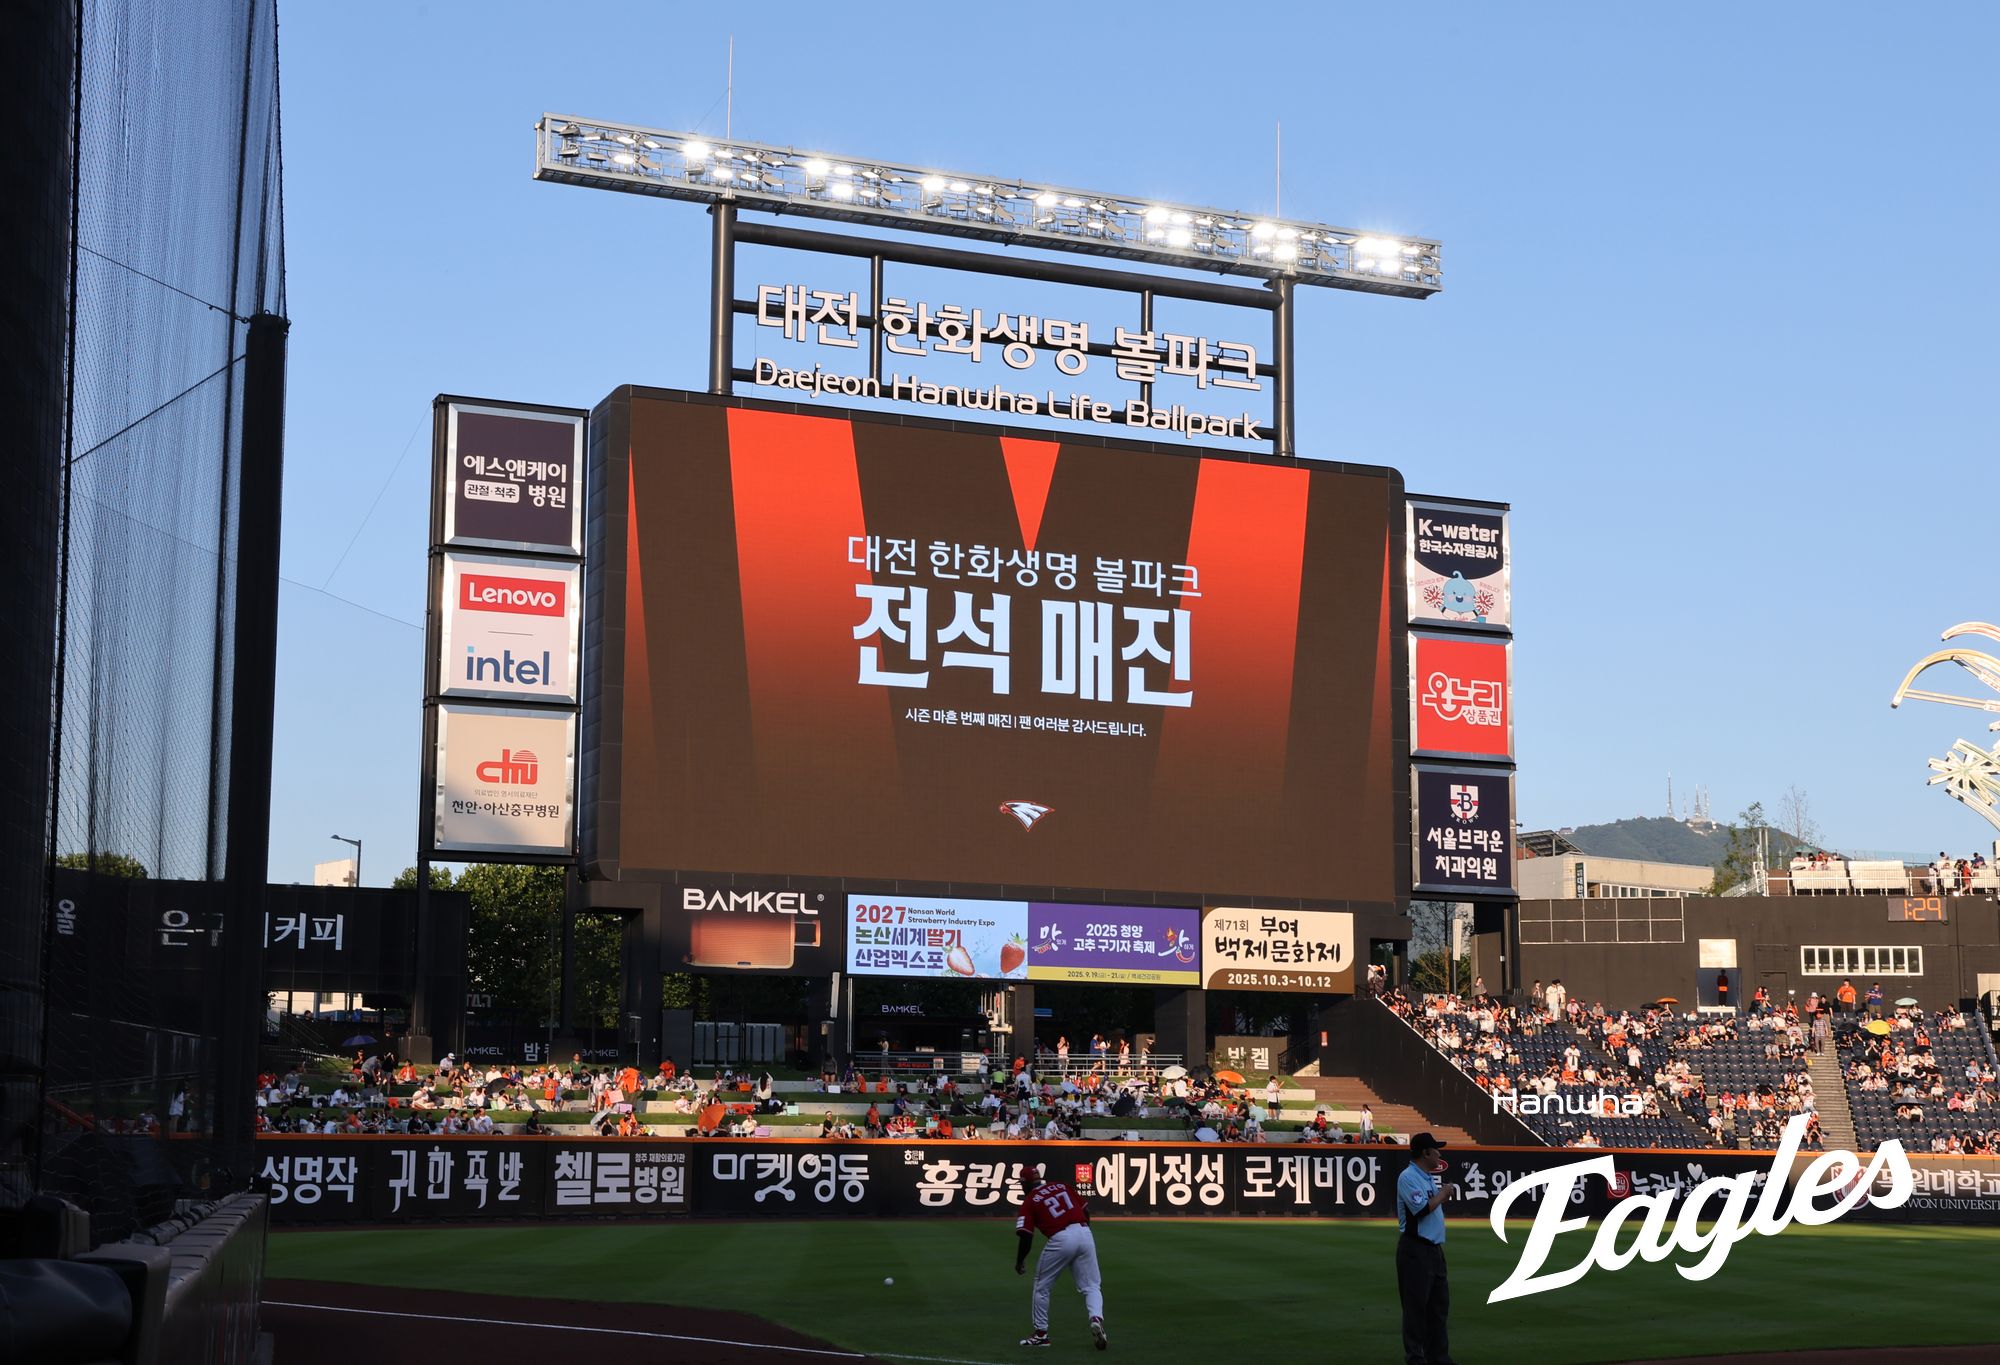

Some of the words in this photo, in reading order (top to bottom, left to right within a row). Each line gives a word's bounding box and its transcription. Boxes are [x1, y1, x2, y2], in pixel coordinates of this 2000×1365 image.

[757, 284, 859, 348] 대전
[880, 297, 1090, 376] 한화생명
[1111, 327, 1261, 391] 볼파크
[755, 357, 880, 398] Daejeon
[892, 373, 1038, 415] Hanwha
[1048, 390, 1112, 424] Life
[1125, 399, 1263, 440] Ballpark
[463, 455, 567, 483] 에스앤케이
[528, 485, 567, 508] 병원
[1418, 518, 1500, 543] K-water
[1419, 538, 1499, 560] 한국수자원공사
[848, 535, 917, 576] 대전
[928, 540, 1078, 591] 한화생명
[1092, 556, 1203, 598] 볼파크
[469, 582, 557, 608] Lenovo
[852, 583, 1012, 696] 전석
[1041, 599, 1194, 708] 매진
[466, 646, 551, 686] intel
[1422, 671, 1503, 721] 온누리
[905, 708, 931, 723] 시즌
[933, 709, 958, 726] 마흔
[960, 711, 986, 727] 번째
[987, 713, 1013, 729] 매진
[1018, 715, 1032, 730] 팬
[1033, 716, 1070, 732] 여러분
[1071, 718, 1148, 738] 감사드립니다.
[1465, 709, 1500, 724] 상품권
[451, 800, 560, 819] 천안·아산충무병원
[1426, 826, 1504, 853] 서울브라운
[1434, 854, 1498, 881] 치과의원
[855, 904, 907, 925] 2027
[907, 907, 935, 916] Nonsan
[935, 908, 956, 917] World
[907, 916, 947, 925] Strawberry
[948, 917, 978, 927] Industry
[978, 918, 996, 927] Expo
[1904, 897, 1942, 920] 1:29
[1086, 923, 1118, 938] 2025
[1120, 924, 1144, 939] 청양
[1214, 918, 1249, 932] 제71회
[1259, 916, 1299, 938] 부여
[855, 948, 945, 970] 산업엑스포
[1073, 937, 1096, 952] 고추
[1097, 938, 1132, 954] 구기자
[1132, 940, 1156, 955] 축제
[1214, 936, 1342, 964] 백제문화제
[1227, 973, 1332, 988] 2025.10.3~10.12
[881, 1004, 925, 1014] BAMKEL
[464, 1046, 504, 1056] AMKEL
[634, 1165, 685, 1204] 병원
[1095, 1153, 1225, 1207] 예가정성
[1242, 1154, 1381, 1207] 로제비앙
[1043, 1191, 1074, 1219] 27
